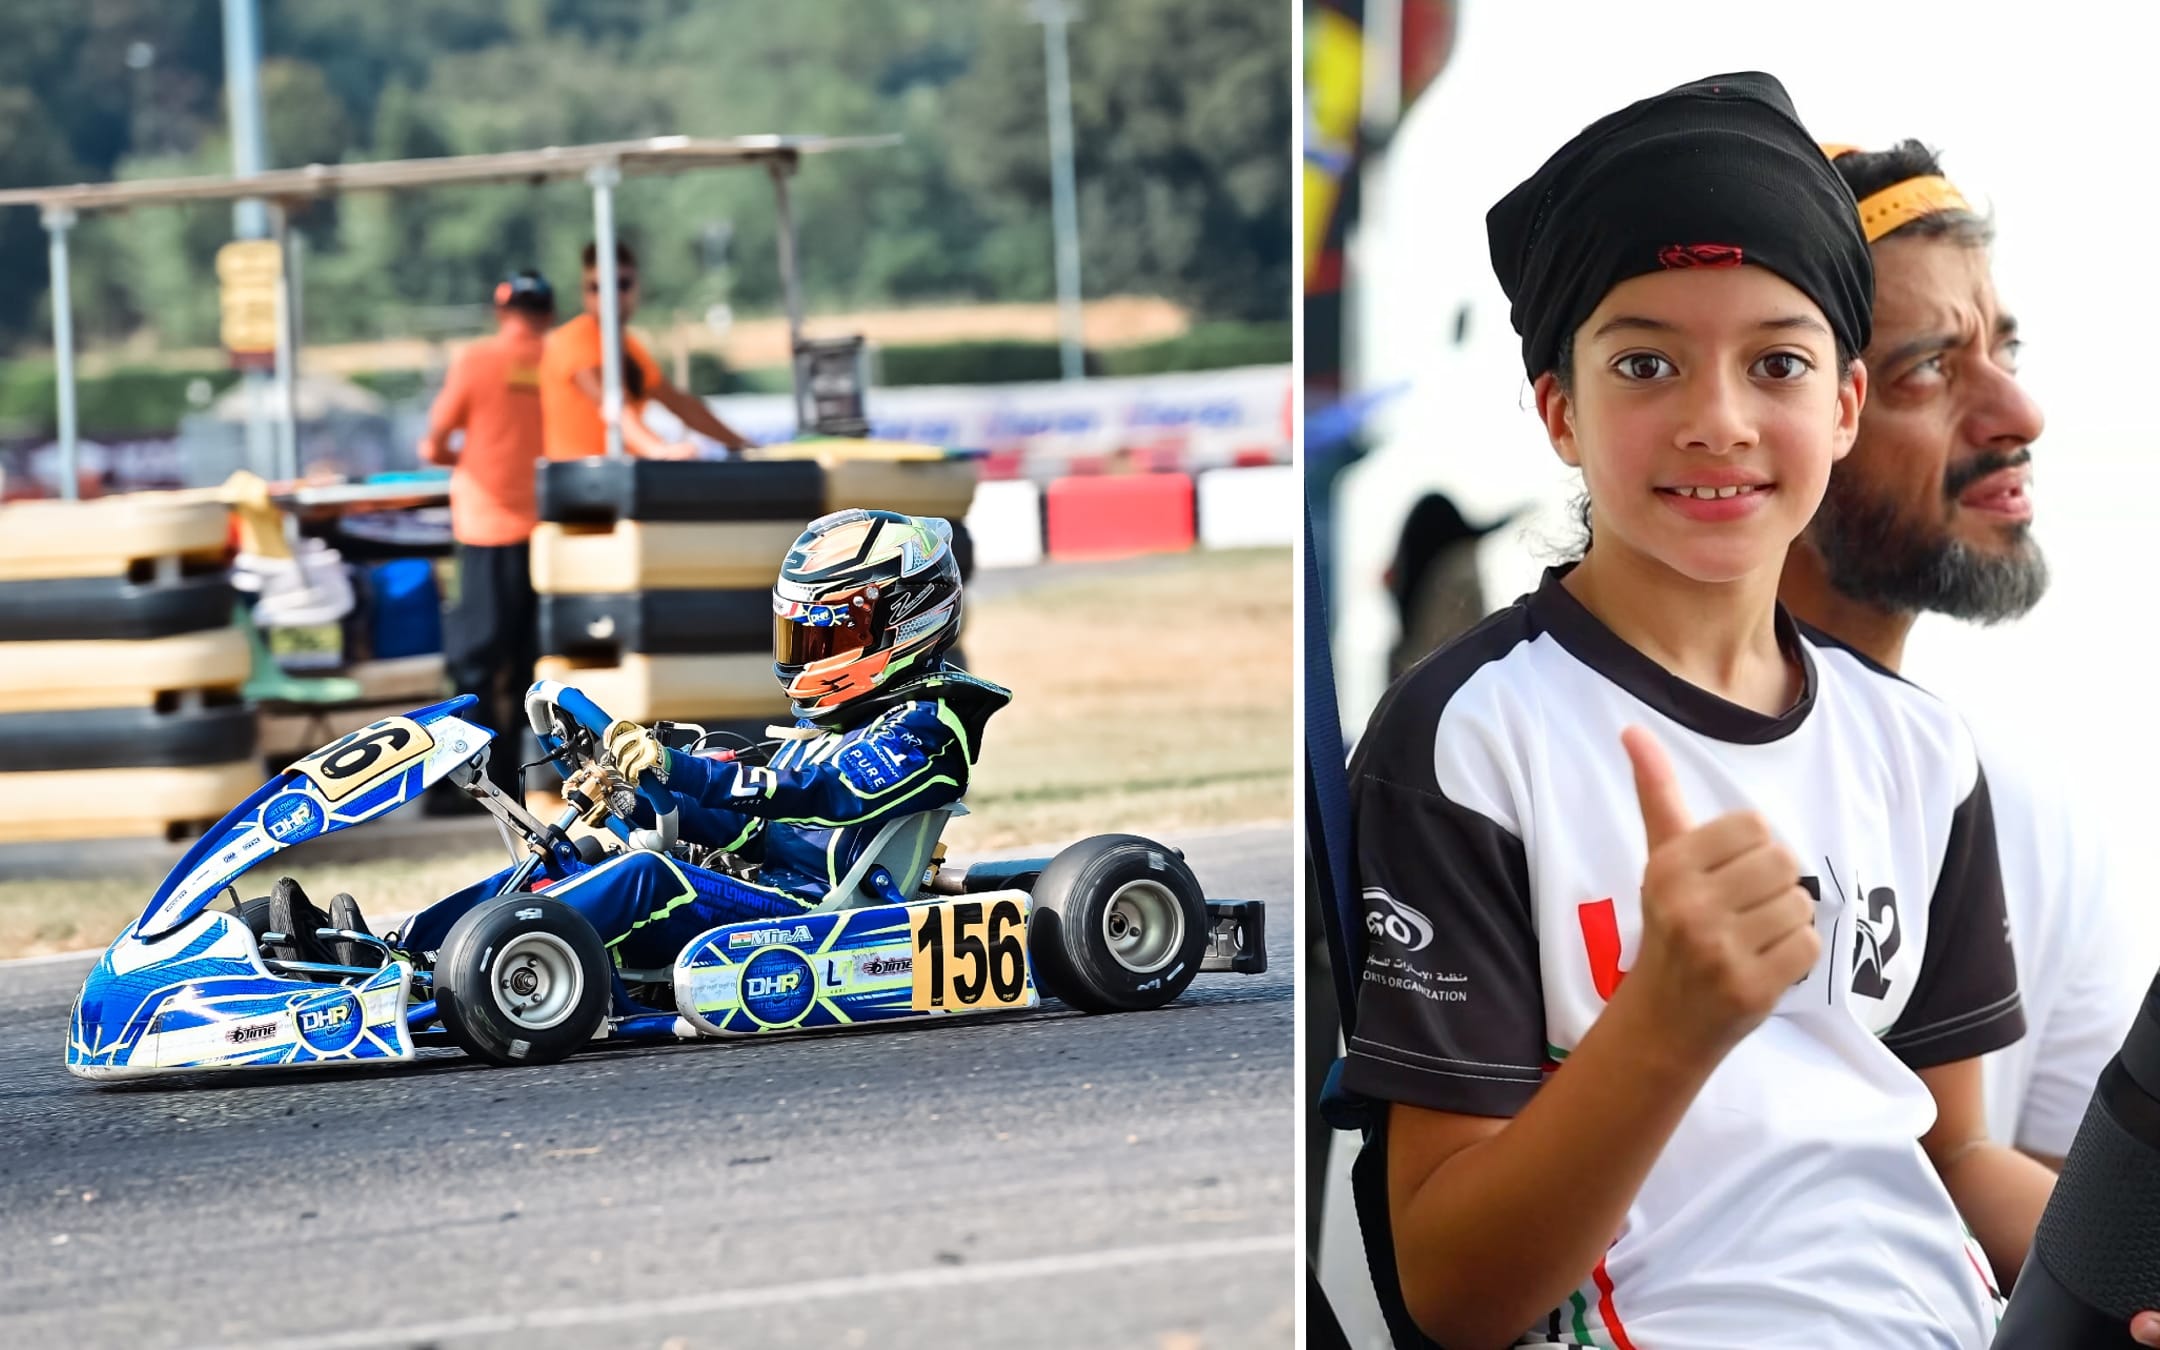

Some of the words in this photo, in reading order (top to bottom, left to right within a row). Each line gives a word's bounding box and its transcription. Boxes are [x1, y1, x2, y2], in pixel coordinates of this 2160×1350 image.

[849, 749, 886, 788] PURE
[269, 803, 313, 840] DHR
[917, 900, 1025, 1007] 156
[746, 973, 799, 997] DHR
[1388, 976, 1468, 1002] ORGANIZATION
[301, 1005, 350, 1031] DHR
